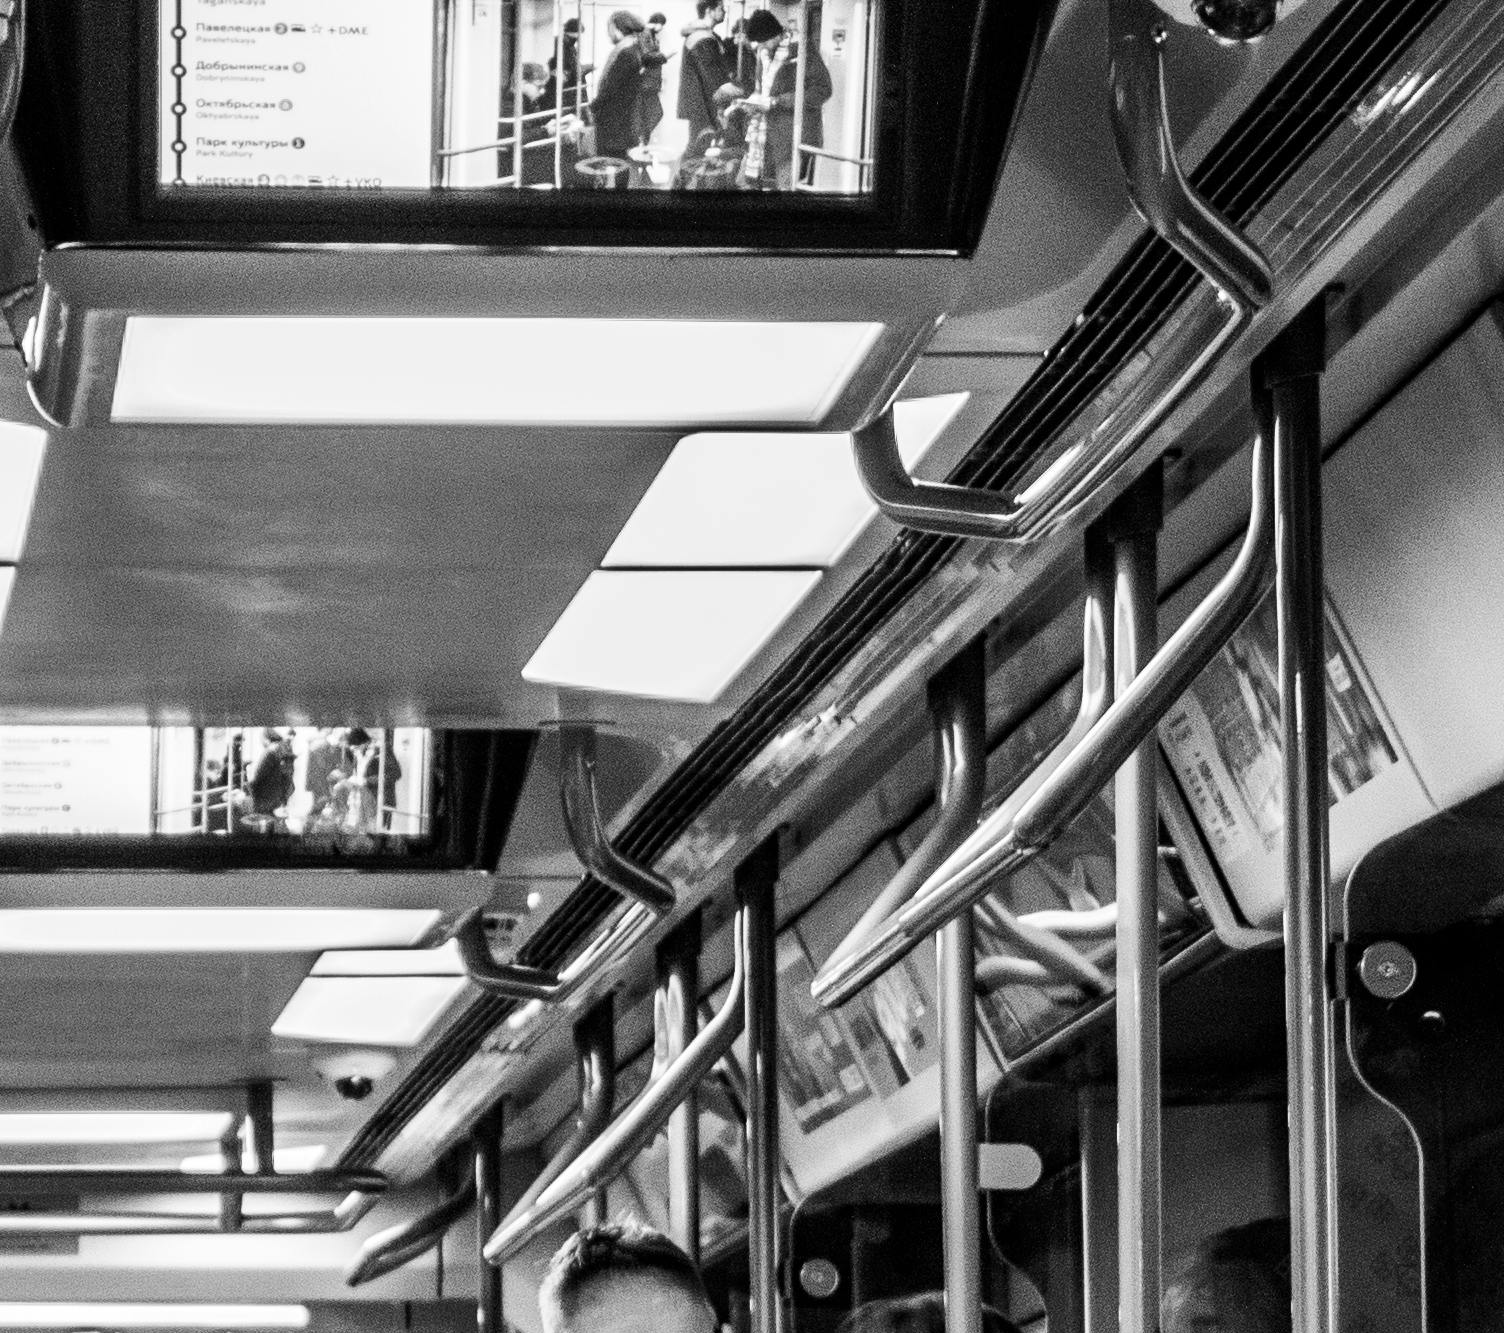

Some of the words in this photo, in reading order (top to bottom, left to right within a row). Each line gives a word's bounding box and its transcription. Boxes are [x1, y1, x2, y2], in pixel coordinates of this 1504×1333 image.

[195, 22, 271, 34] Павелецкая
[338, 26, 369, 35] DME
[195, 60, 289, 72] Добрынинская
[195, 98, 276, 109] Октябрьская
[195, 137, 227, 148] Парк
[231, 138, 289, 148] культуры
[196, 174, 253, 185] Киевская
